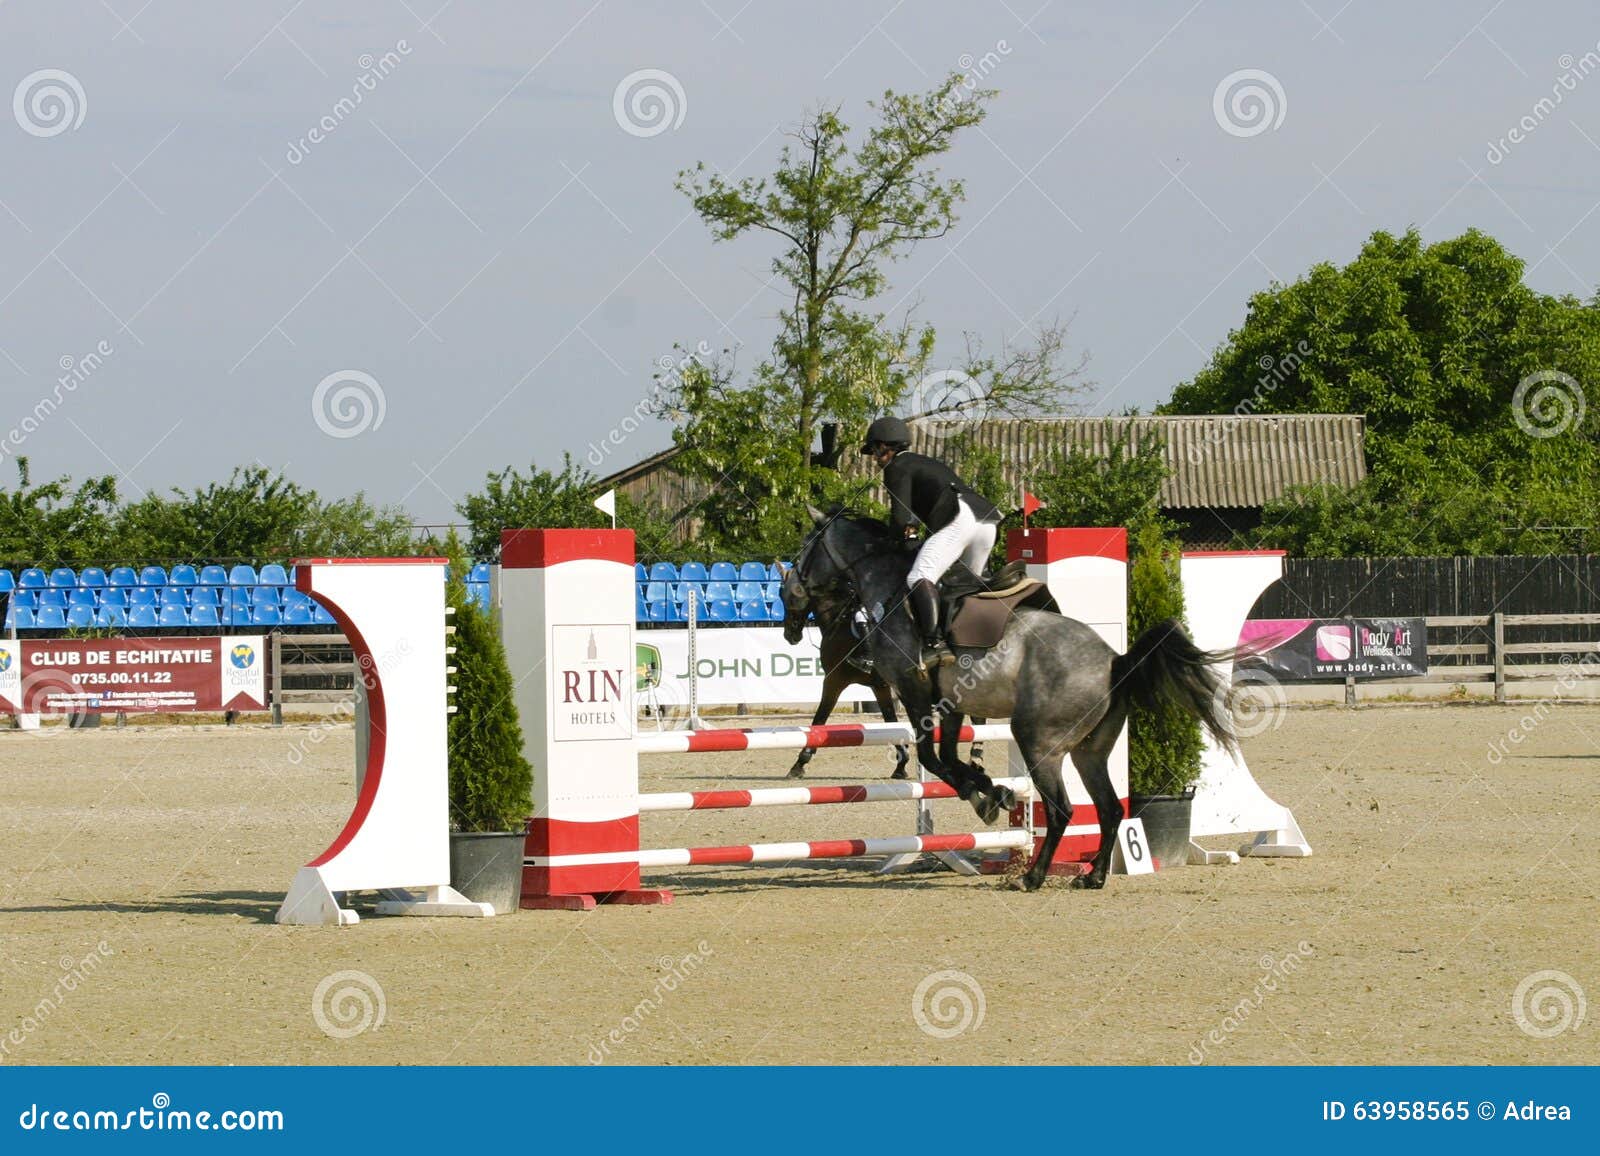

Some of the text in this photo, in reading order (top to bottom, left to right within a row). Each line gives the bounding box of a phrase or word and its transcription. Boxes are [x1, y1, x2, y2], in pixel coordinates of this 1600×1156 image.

[1361, 627, 1411, 647] Body Art
[31, 649, 212, 666] CLUB DE ECHITATIE
[1362, 645, 1412, 657] Wellness Club
[676, 653, 826, 679] JOHN DEE
[1316, 662, 1413, 673] www.body-art.ro
[72, 672, 171, 684] 0735.00.11.22
[562, 669, 623, 703] RIN
[571, 711, 616, 725] HOTELS
[1126, 826, 1143, 862] 6
